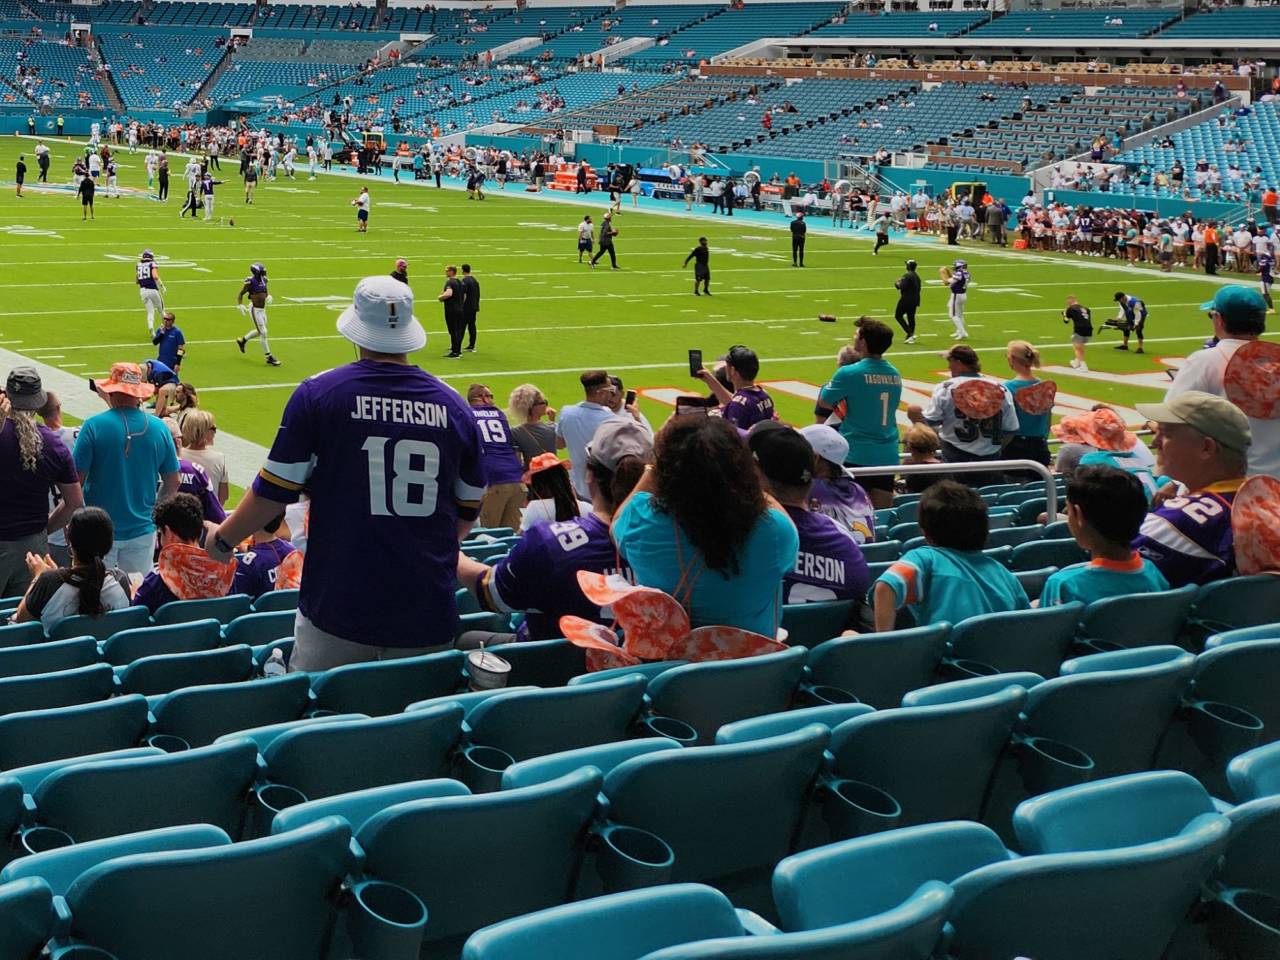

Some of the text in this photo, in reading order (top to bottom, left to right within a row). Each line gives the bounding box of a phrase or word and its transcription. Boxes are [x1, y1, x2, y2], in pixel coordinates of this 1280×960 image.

[351, 395, 448, 429] JEFFERSON
[880, 392, 889, 426] 1
[477, 419, 507, 443] 19
[361, 436, 440, 517] 18
